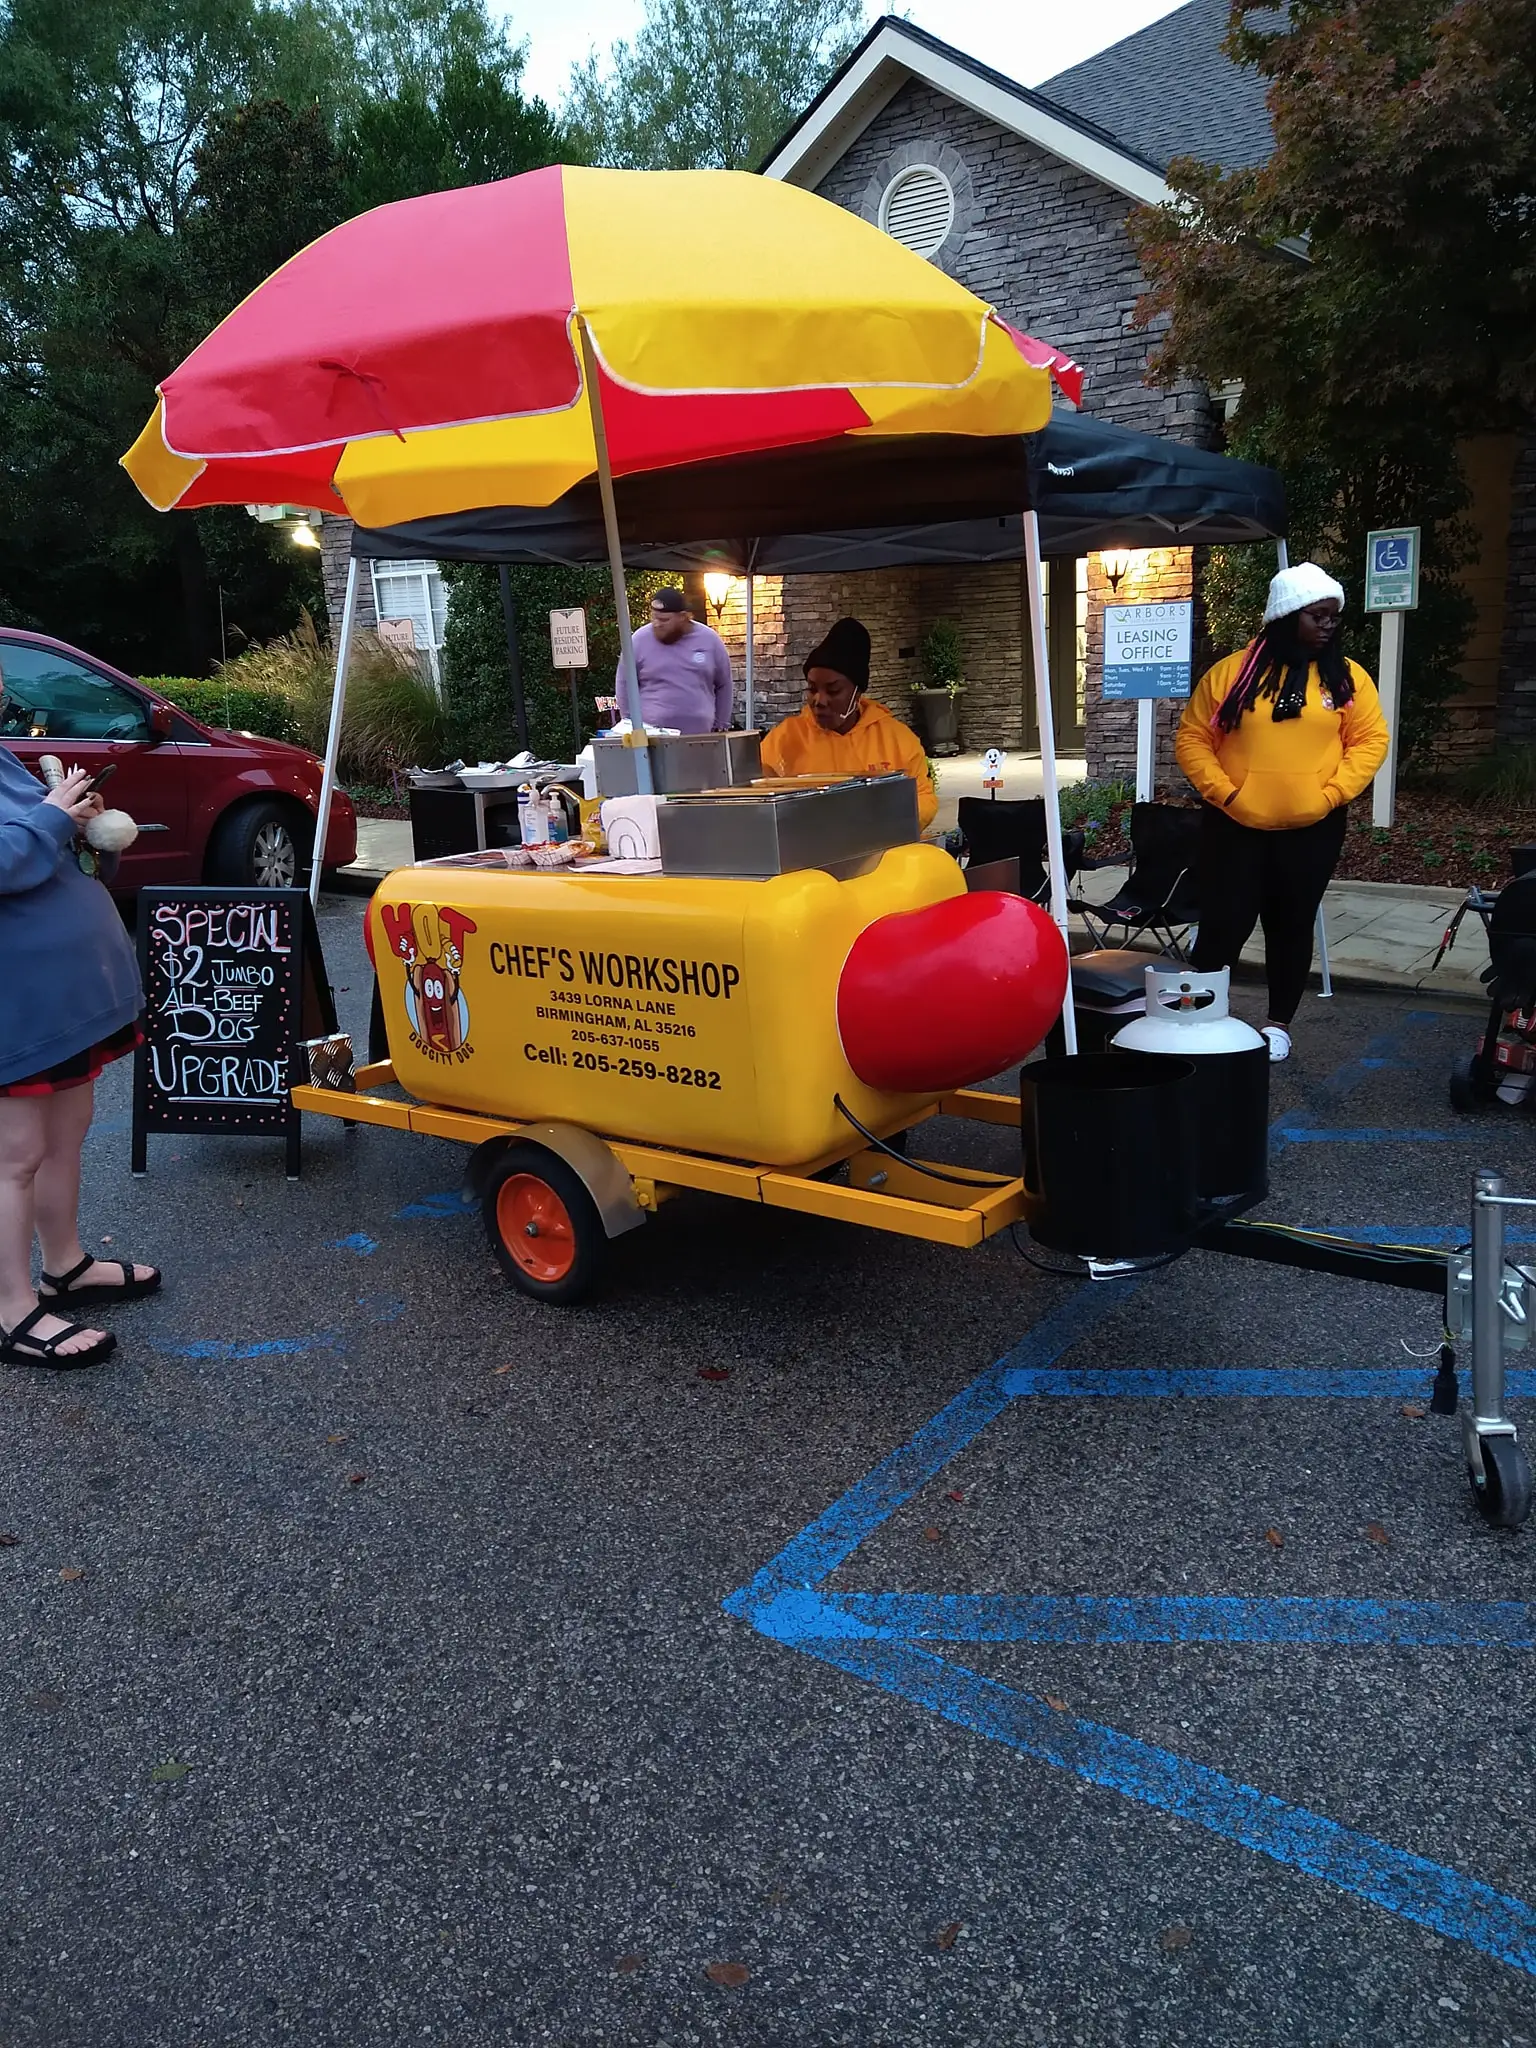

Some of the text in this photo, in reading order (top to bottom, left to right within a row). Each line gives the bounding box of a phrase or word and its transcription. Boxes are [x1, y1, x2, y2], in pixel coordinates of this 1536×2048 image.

[1124, 605, 1186, 619] ARBORS
[554, 635, 584, 645] RESIDENT
[556, 625, 580, 635] FUTURE
[1117, 628, 1178, 644] LEASING
[556, 646, 584, 655] PARKING
[1121, 645, 1173, 660] OFFICE
[152, 904, 291, 953] SPECIAL
[380, 902, 478, 972] HOT
[159, 944, 275, 988] $2 JUMBO
[489, 942, 740, 1000] CHEF'S WORKSHOP
[158, 986, 264, 1014] ALL-BEEF
[549, 990, 676, 1016] 3439 LORNA LANE
[164, 1007, 261, 1042] DOG
[536, 1006, 696, 1038] BIRMINGHAM, AL 35216
[455, 1042, 475, 1064] DOG
[571, 1029, 660, 1052] 205-637-1055
[151, 1045, 289, 1097] UPGRADE
[523, 1043, 722, 1091] Cell: 205-259-8282
